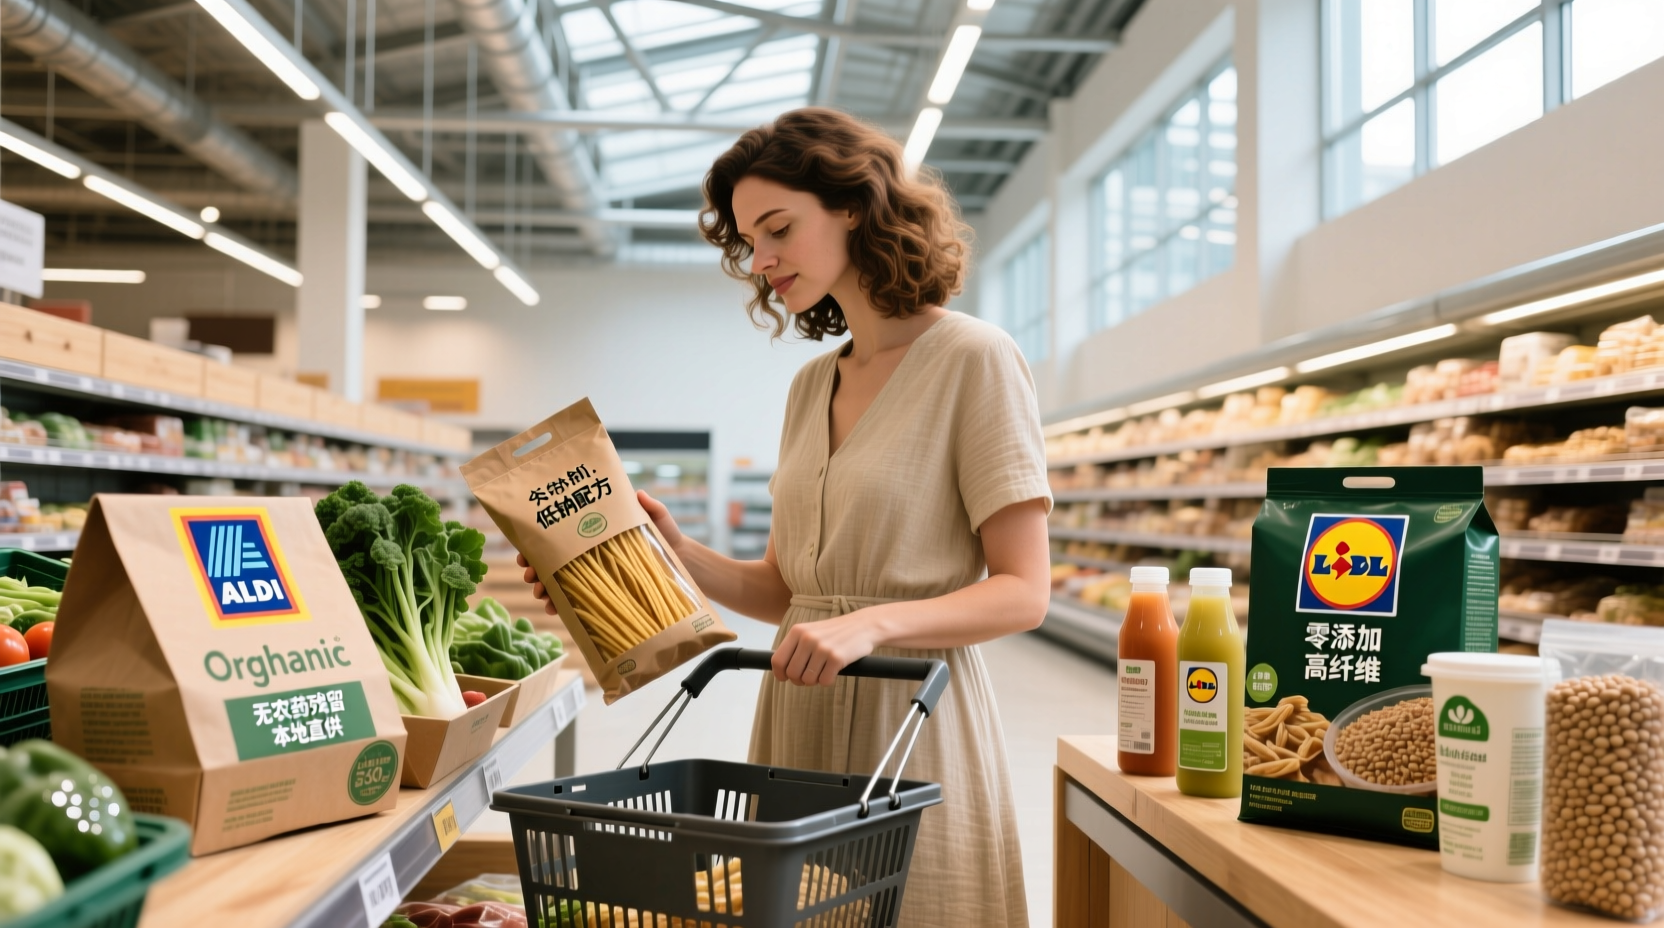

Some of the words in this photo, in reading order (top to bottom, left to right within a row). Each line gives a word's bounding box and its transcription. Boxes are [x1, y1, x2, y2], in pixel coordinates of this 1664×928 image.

[222, 579, 284, 605] ALDI
[1305, 622, 1382, 651] 零添加
[204, 639, 351, 687] Orghanic
[1305, 653, 1381, 683] 高纤维
[252, 690, 345, 726] 无农药残留
[272, 715, 344, 748] 本地直供
